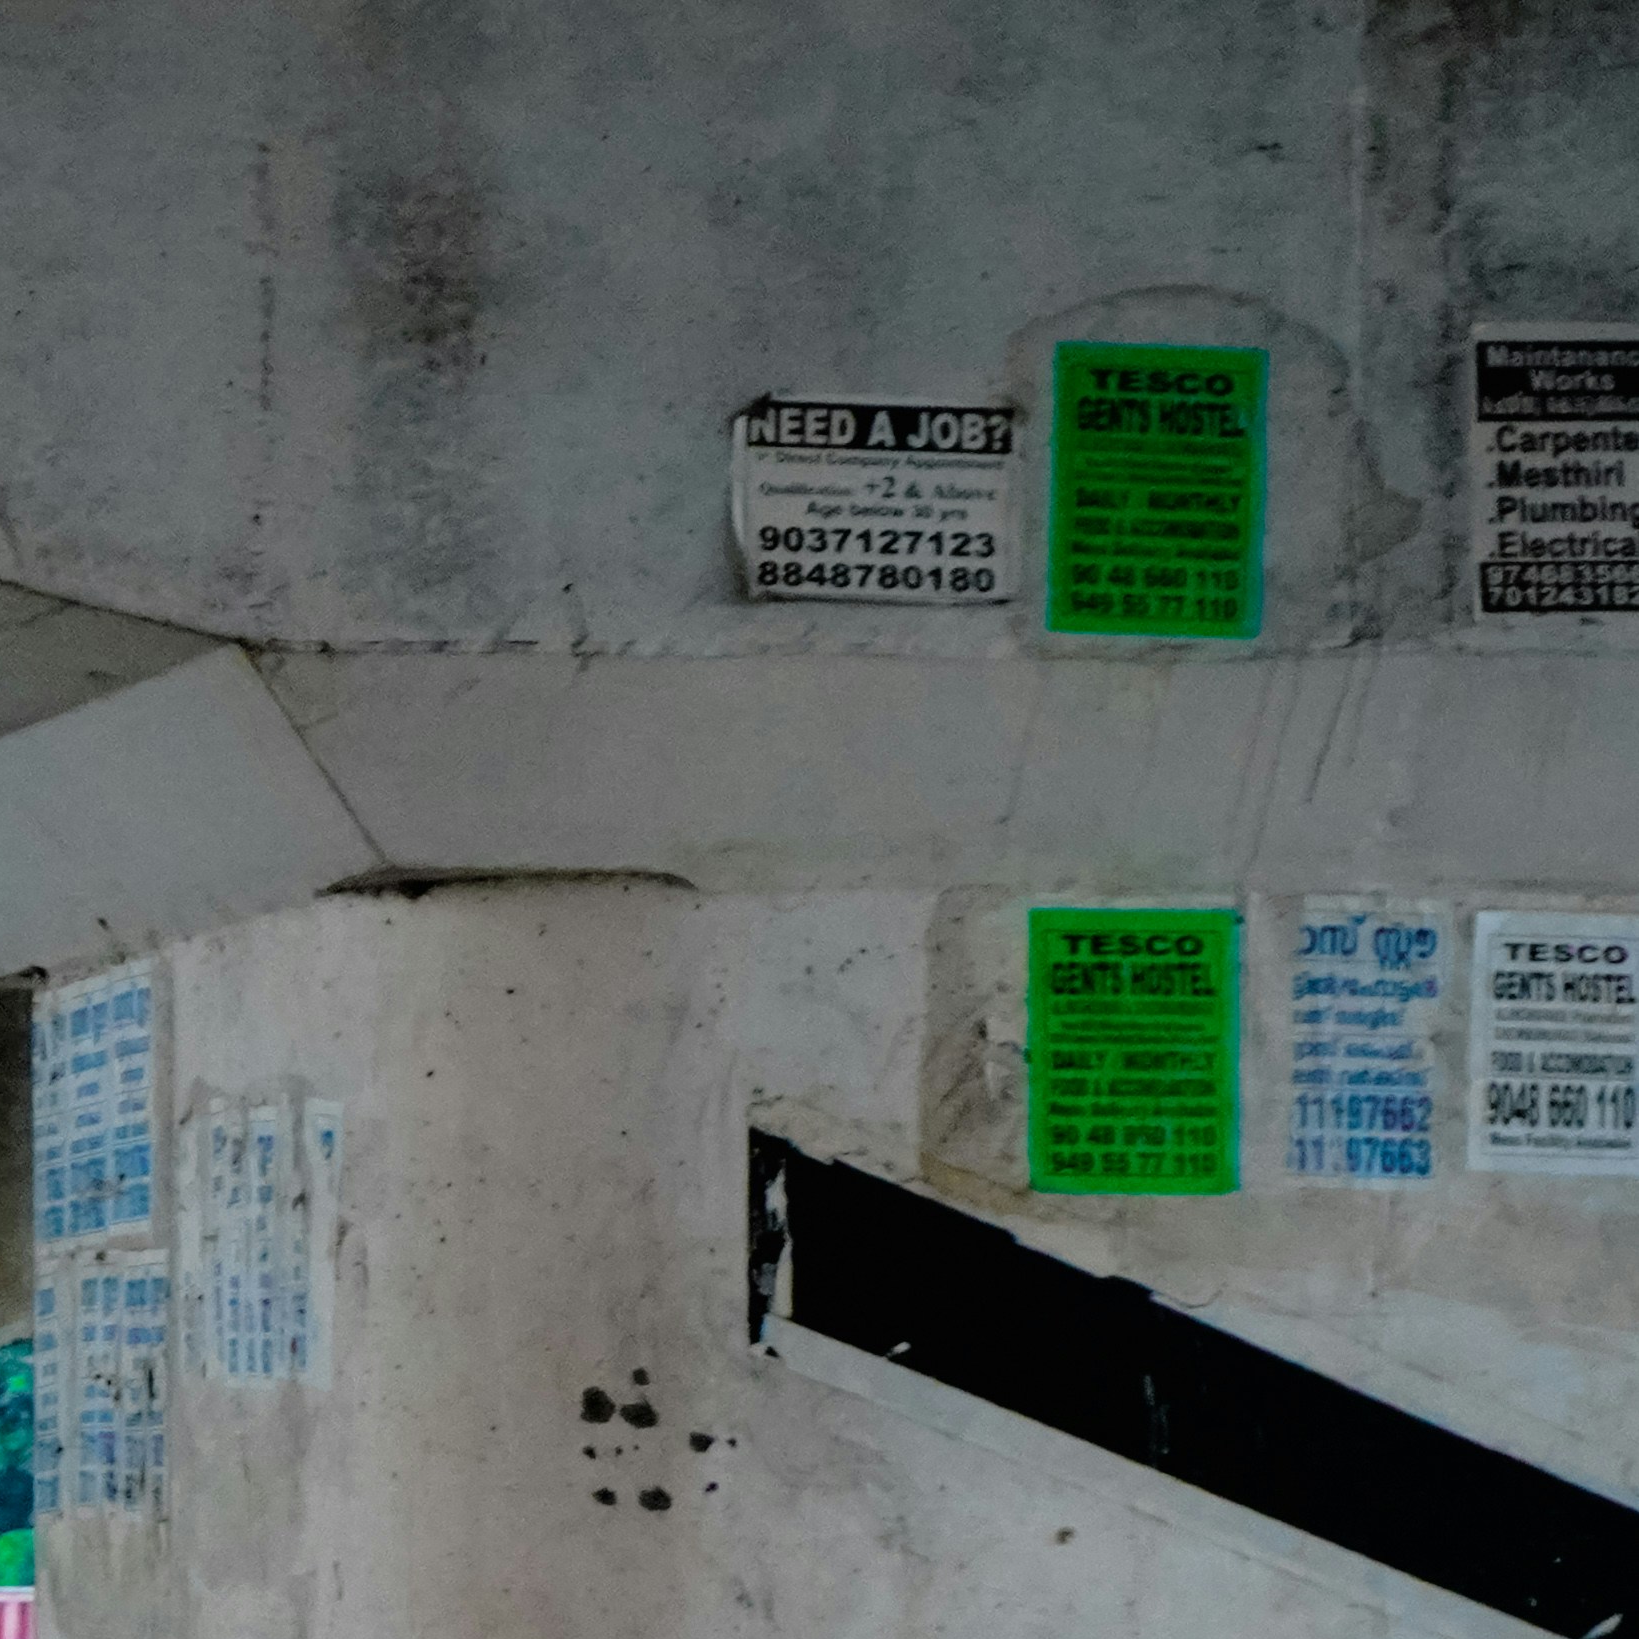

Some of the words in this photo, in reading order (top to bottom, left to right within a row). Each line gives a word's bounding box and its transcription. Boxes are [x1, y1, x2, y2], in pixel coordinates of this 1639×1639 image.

[1089, 368, 1234, 396] TESCO
[748, 407, 857, 446] NEED
[867, 411, 896, 448] A
[906, 412, 1011, 451] JOB?
[866, 476, 895, 498] +2
[759, 526, 995, 557] 9037127123
[758, 561, 994, 592] 8848780180
[1062, 934, 1203, 956] TESCO
[1503, 942, 1629, 964] TESCO
